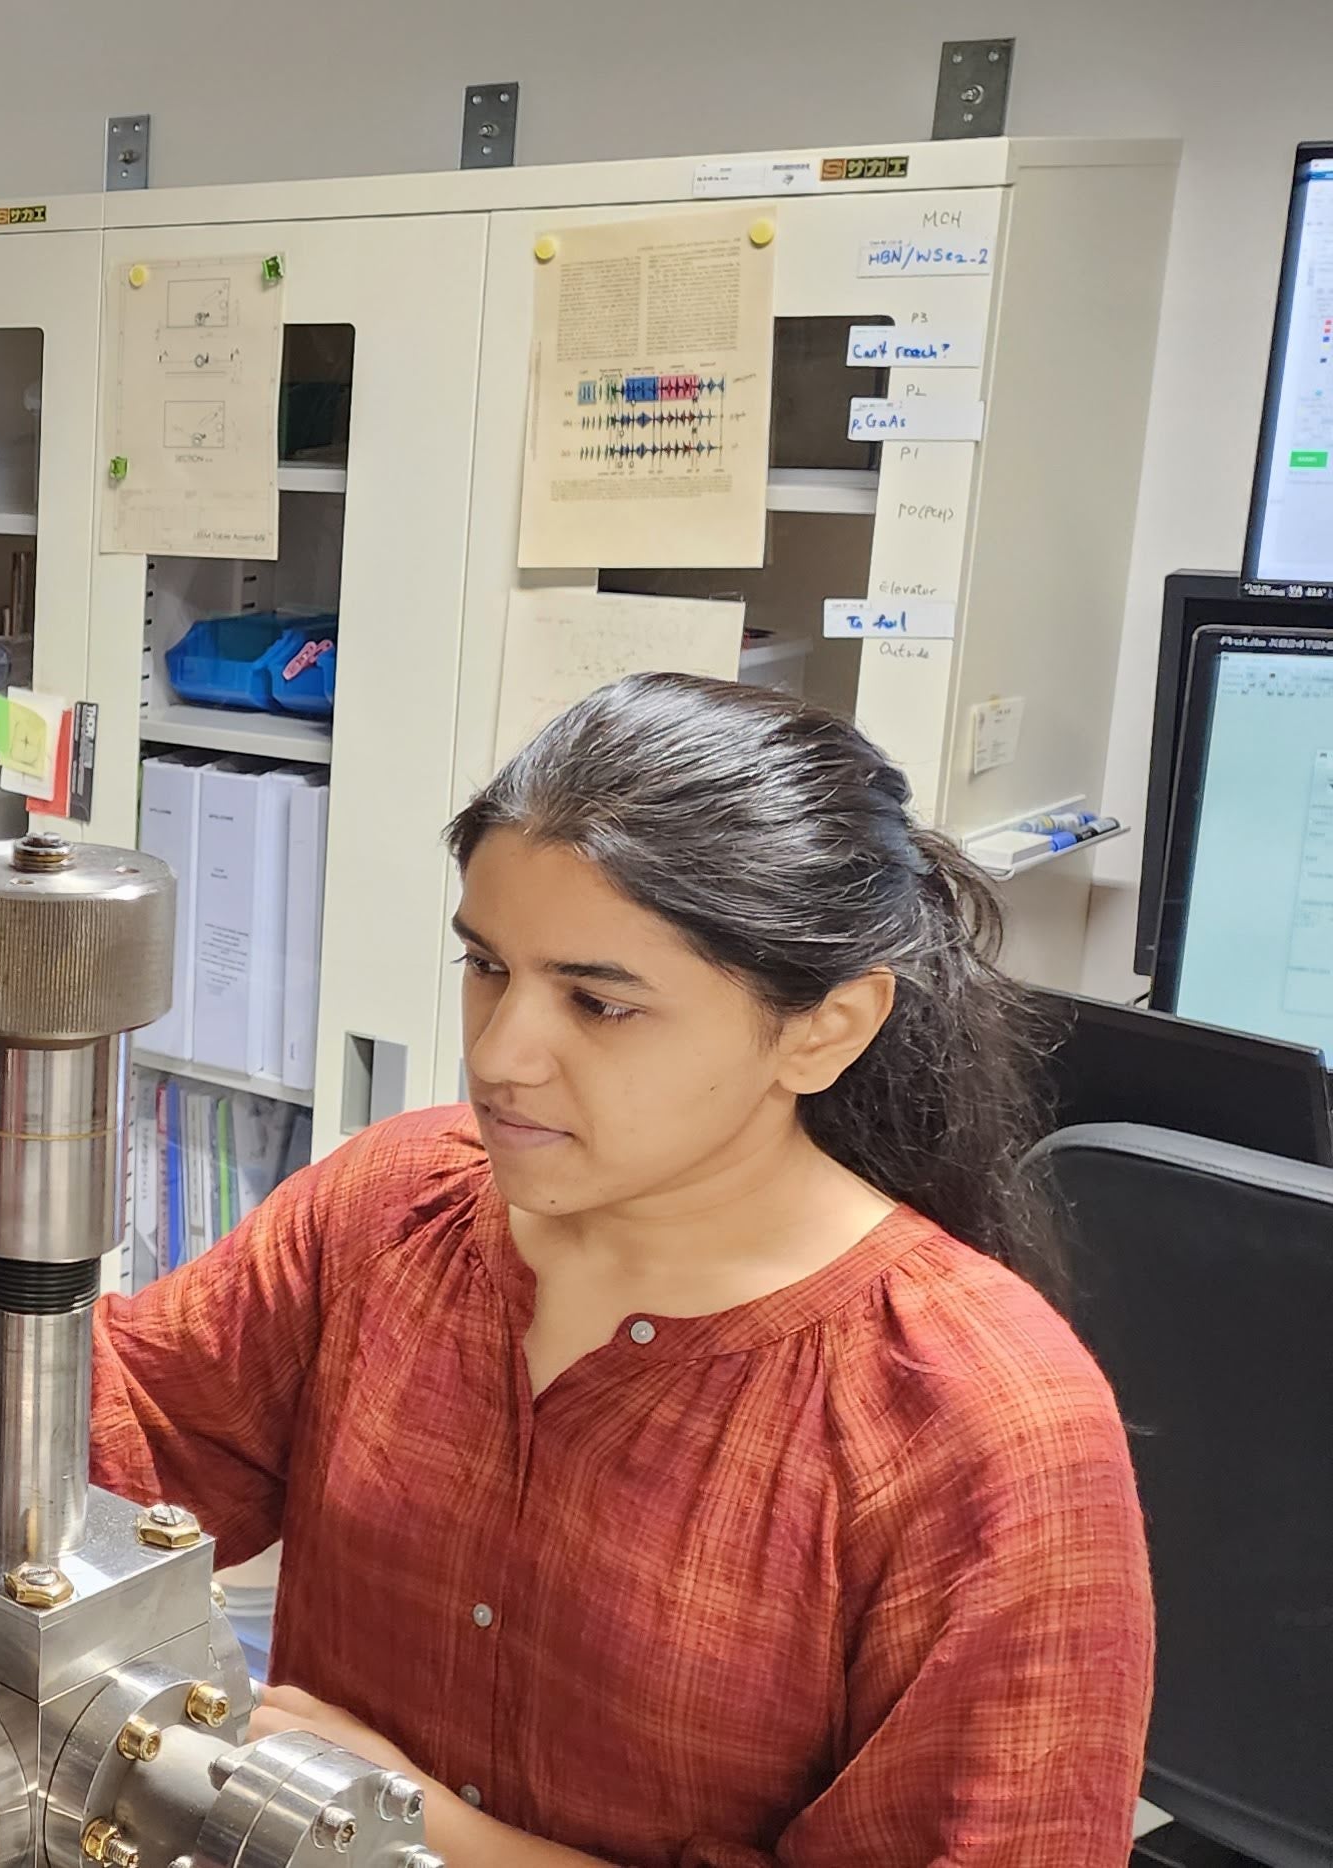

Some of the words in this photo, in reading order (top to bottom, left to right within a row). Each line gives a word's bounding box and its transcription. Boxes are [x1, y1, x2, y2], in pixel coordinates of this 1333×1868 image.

[923, 210, 961, 228] MCH
[911, 312, 928, 323] P3
[906, 384, 927, 397] P2
[900, 446, 919, 460] P1
